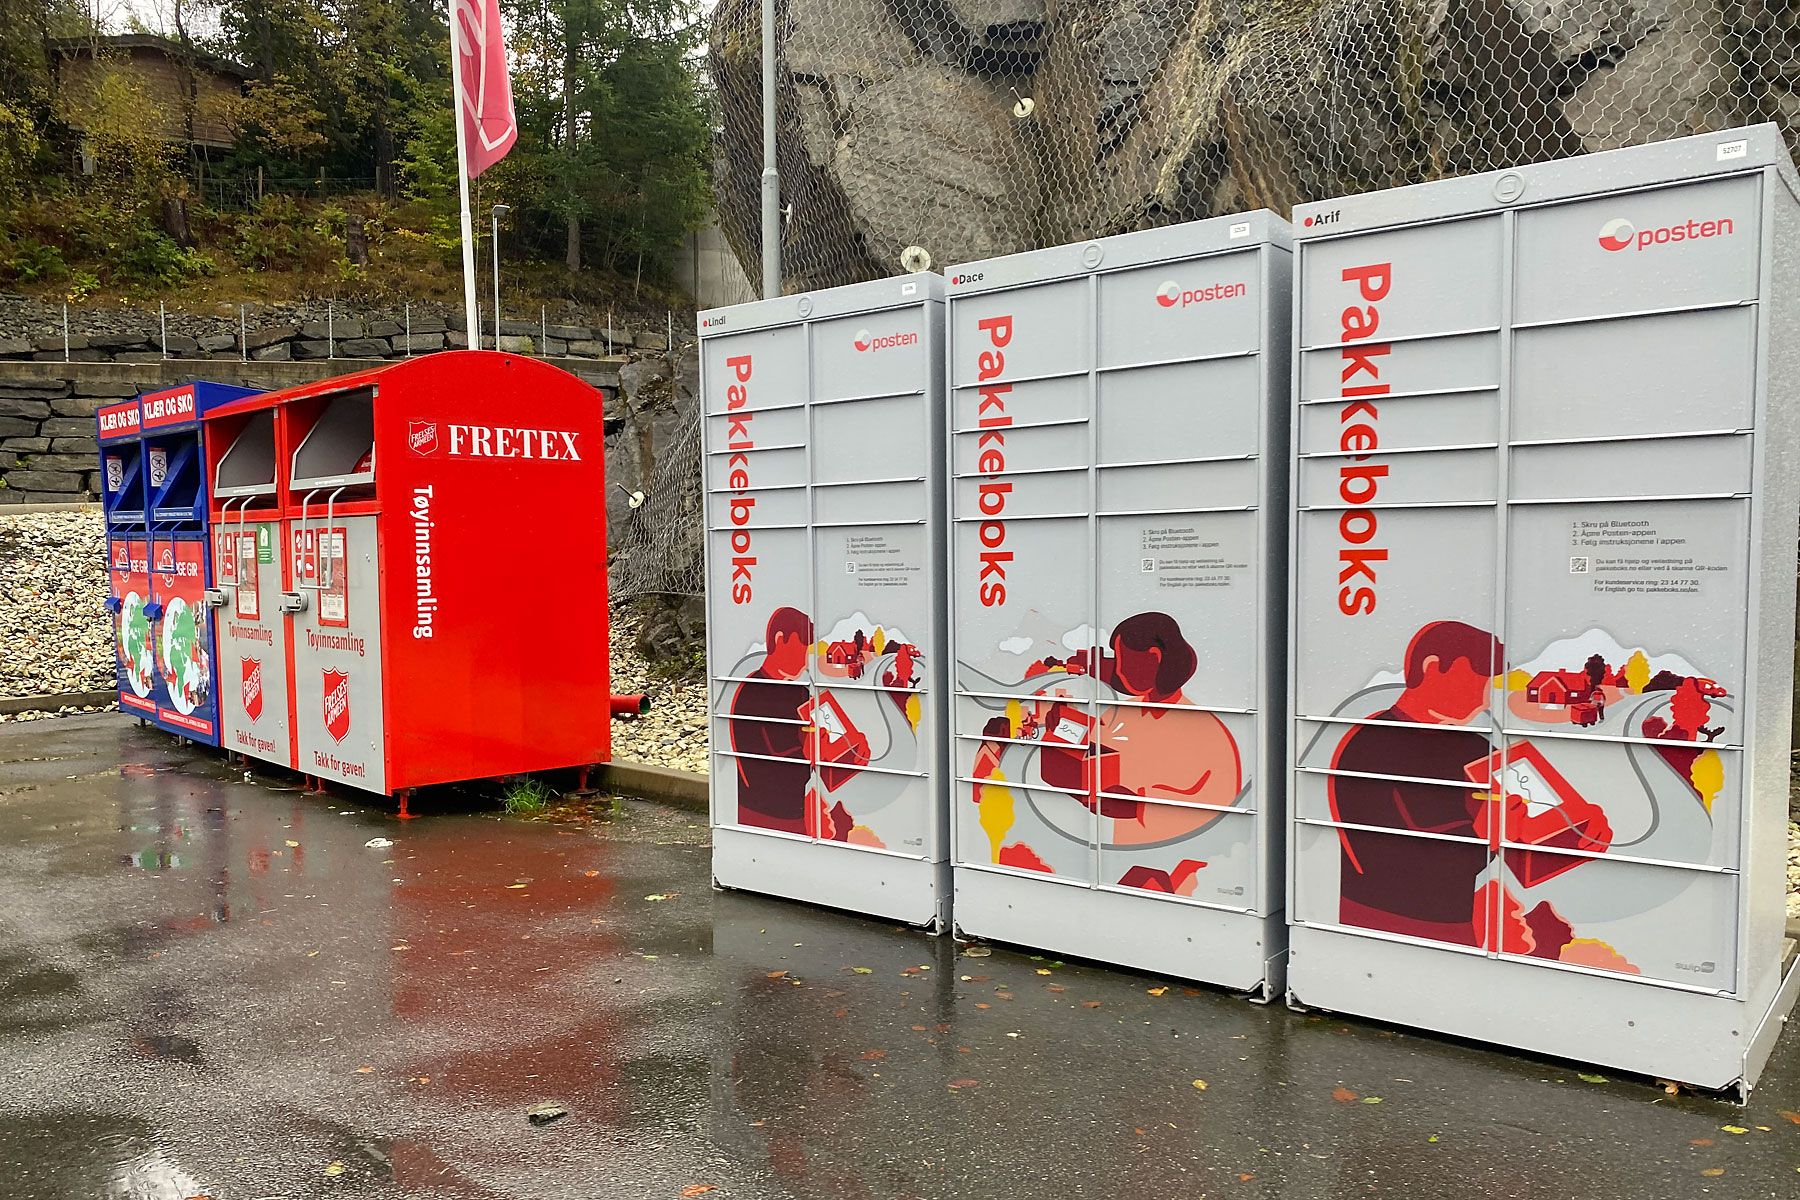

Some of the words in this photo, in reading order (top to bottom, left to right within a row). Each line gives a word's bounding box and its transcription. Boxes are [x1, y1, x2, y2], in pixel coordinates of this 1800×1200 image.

[1314, 210, 1341, 227] Arif
[1637, 218, 1734, 252] posten
[958, 271, 984, 285] Dace
[1182, 281, 1246, 308] posten
[872, 331, 918, 352] posten
[100, 413, 118, 431] KLÆR
[117, 411, 127, 428] OG
[127, 408, 140, 427] SKO
[143, 400, 165, 420] KLÆR
[165, 397, 177, 416] OG
[177, 393, 193, 414] SKO
[447, 424, 582, 461] FRETEX
[1337, 262, 1392, 617] Pakkeboks
[978, 314, 1014, 608] Pakkeboks
[726, 354, 758, 605] Pakkeboks
[1599, 520, 1609, 529] på
[409, 484, 438, 639] Tøyinnsamling
[228, 621, 273, 647] Tøyinnsamling
[306, 628, 365, 657] Tøyinnsamling
[236, 729, 249, 745] Takk
[249, 732, 257, 748] for
[257, 735, 276, 753] gaven!
[314, 750, 330, 768] Takk
[330, 754, 341, 772] for
[341, 760, 365, 778] gaven!
